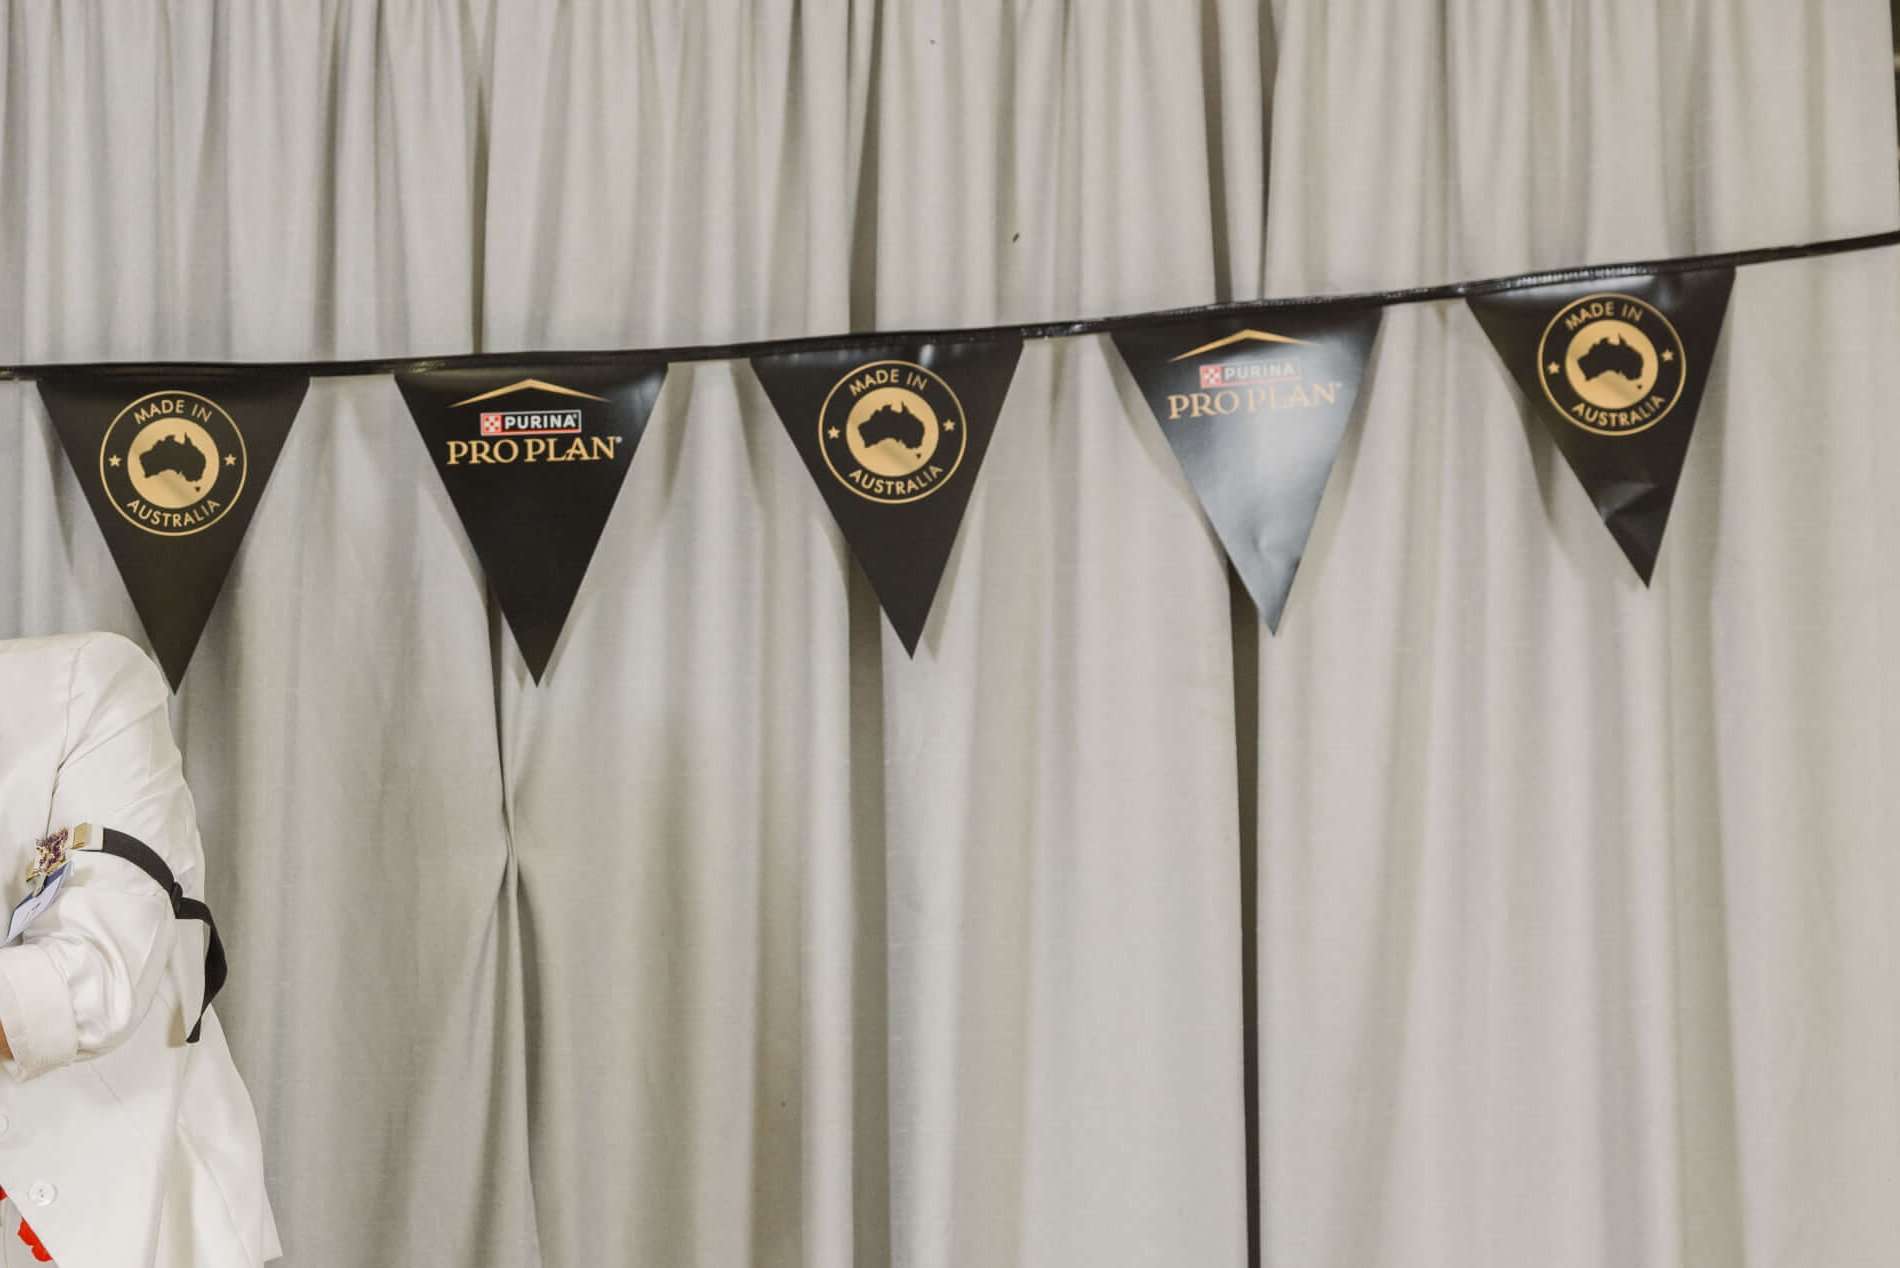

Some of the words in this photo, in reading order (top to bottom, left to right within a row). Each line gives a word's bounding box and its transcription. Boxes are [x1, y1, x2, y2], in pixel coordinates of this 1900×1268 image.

[1564, 301, 1614, 331] MADE
[1620, 304, 1643, 322] IN
[849, 368, 899, 396] MADE
[906, 371, 928, 391] IN
[1223, 361, 1296, 382] PURINA
[134, 399, 185, 425] MADE
[191, 403, 212, 423] IN
[1167, 389, 1240, 420] PRO
[1571, 395, 1665, 427] AUSTRALIA
[504, 413, 577, 430] PURINA
[446, 438, 519, 464] PRO
[848, 465, 943, 495] AUSTRALIA
[126, 499, 221, 528] AUSTRALIA
